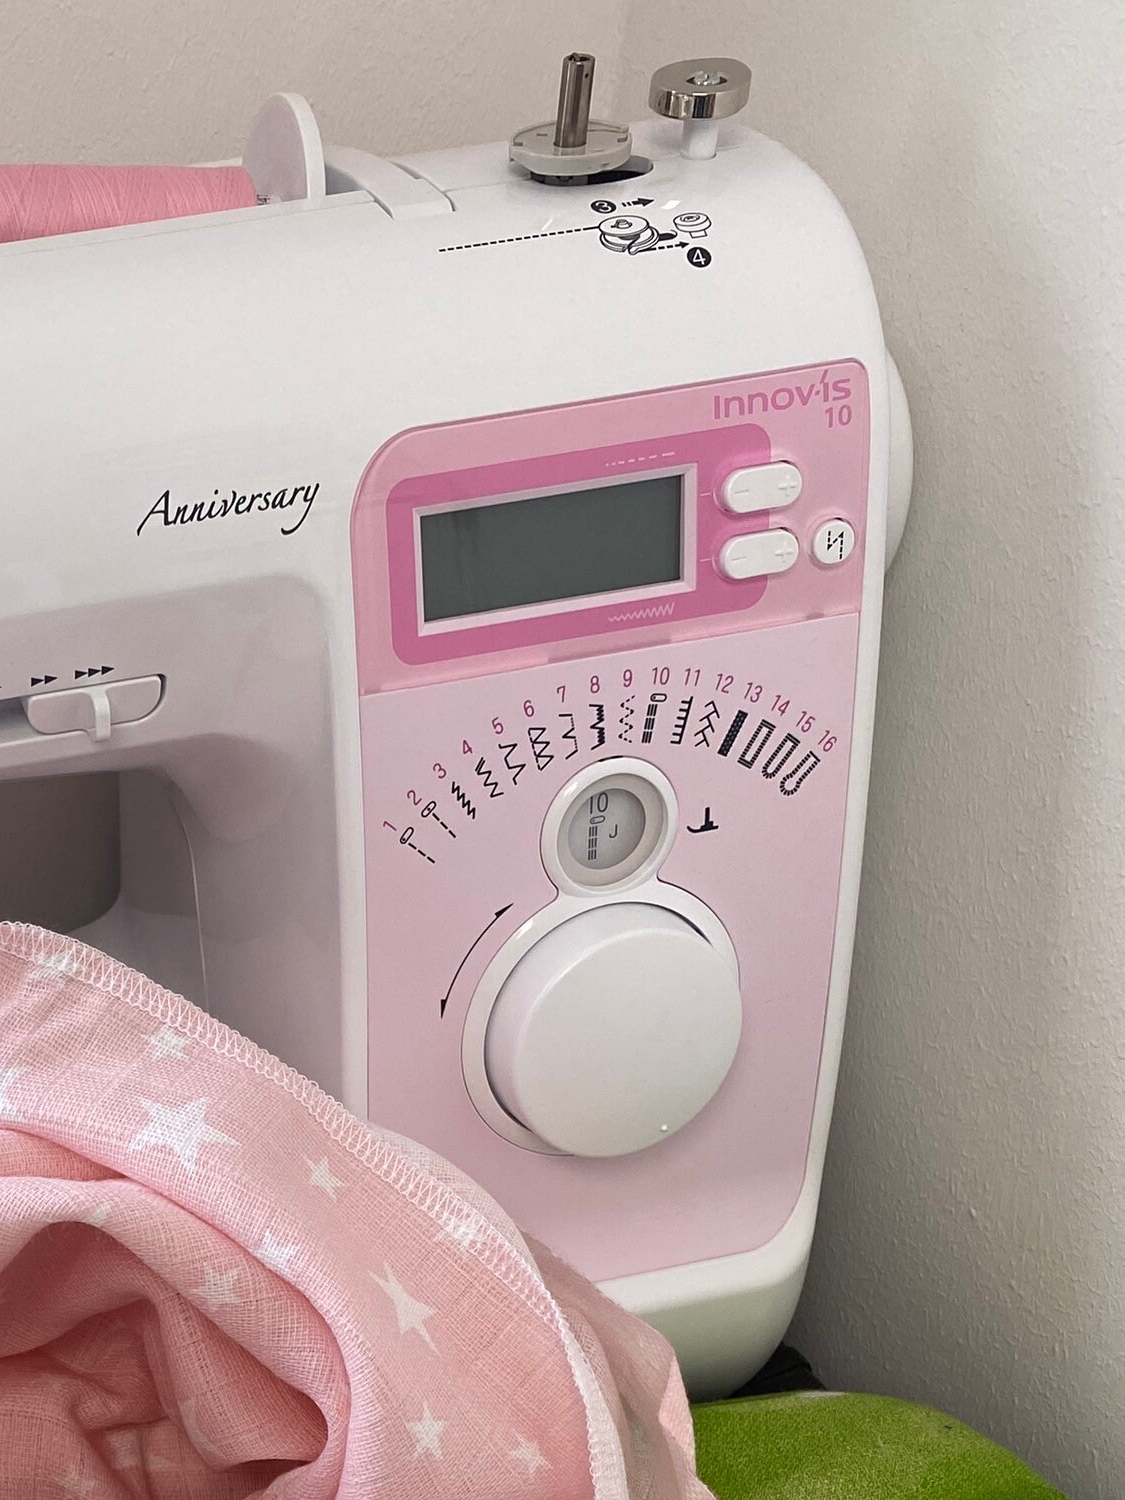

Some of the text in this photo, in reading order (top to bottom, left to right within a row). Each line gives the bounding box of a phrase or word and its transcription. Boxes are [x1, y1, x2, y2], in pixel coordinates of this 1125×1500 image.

[825, 405, 853, 428] 10
[136, 483, 320, 536] Anniversary
[382, 667, 838, 832] 1 2 3 4 5 6 7 8 9 10 11 12 13 14 15 16
[587, 792, 610, 814] 10
[608, 824, 619, 839] J
